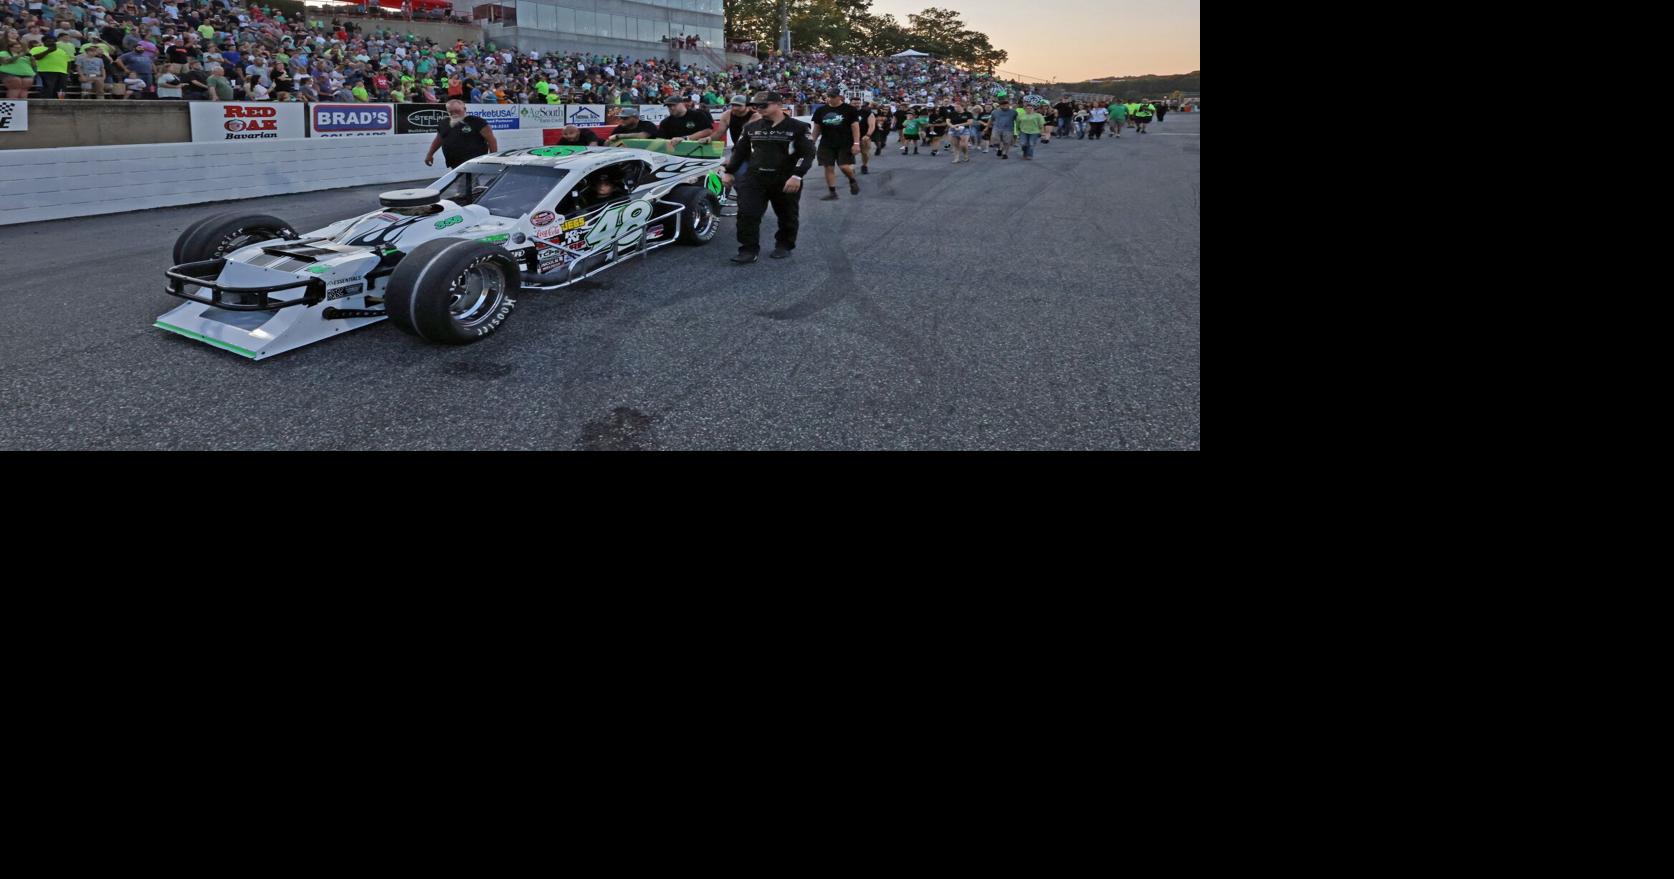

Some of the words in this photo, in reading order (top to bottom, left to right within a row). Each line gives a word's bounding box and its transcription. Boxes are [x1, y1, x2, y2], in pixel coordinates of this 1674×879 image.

[224, 105, 277, 118] RED
[317, 111, 388, 125] BRAD'S
[528, 106, 563, 120] AgSouth
[224, 120, 277, 131] OAK
[225, 131, 277, 140] Bavarian
[585, 200, 653, 251] 48
[477, 296, 517, 336] Hoosier
